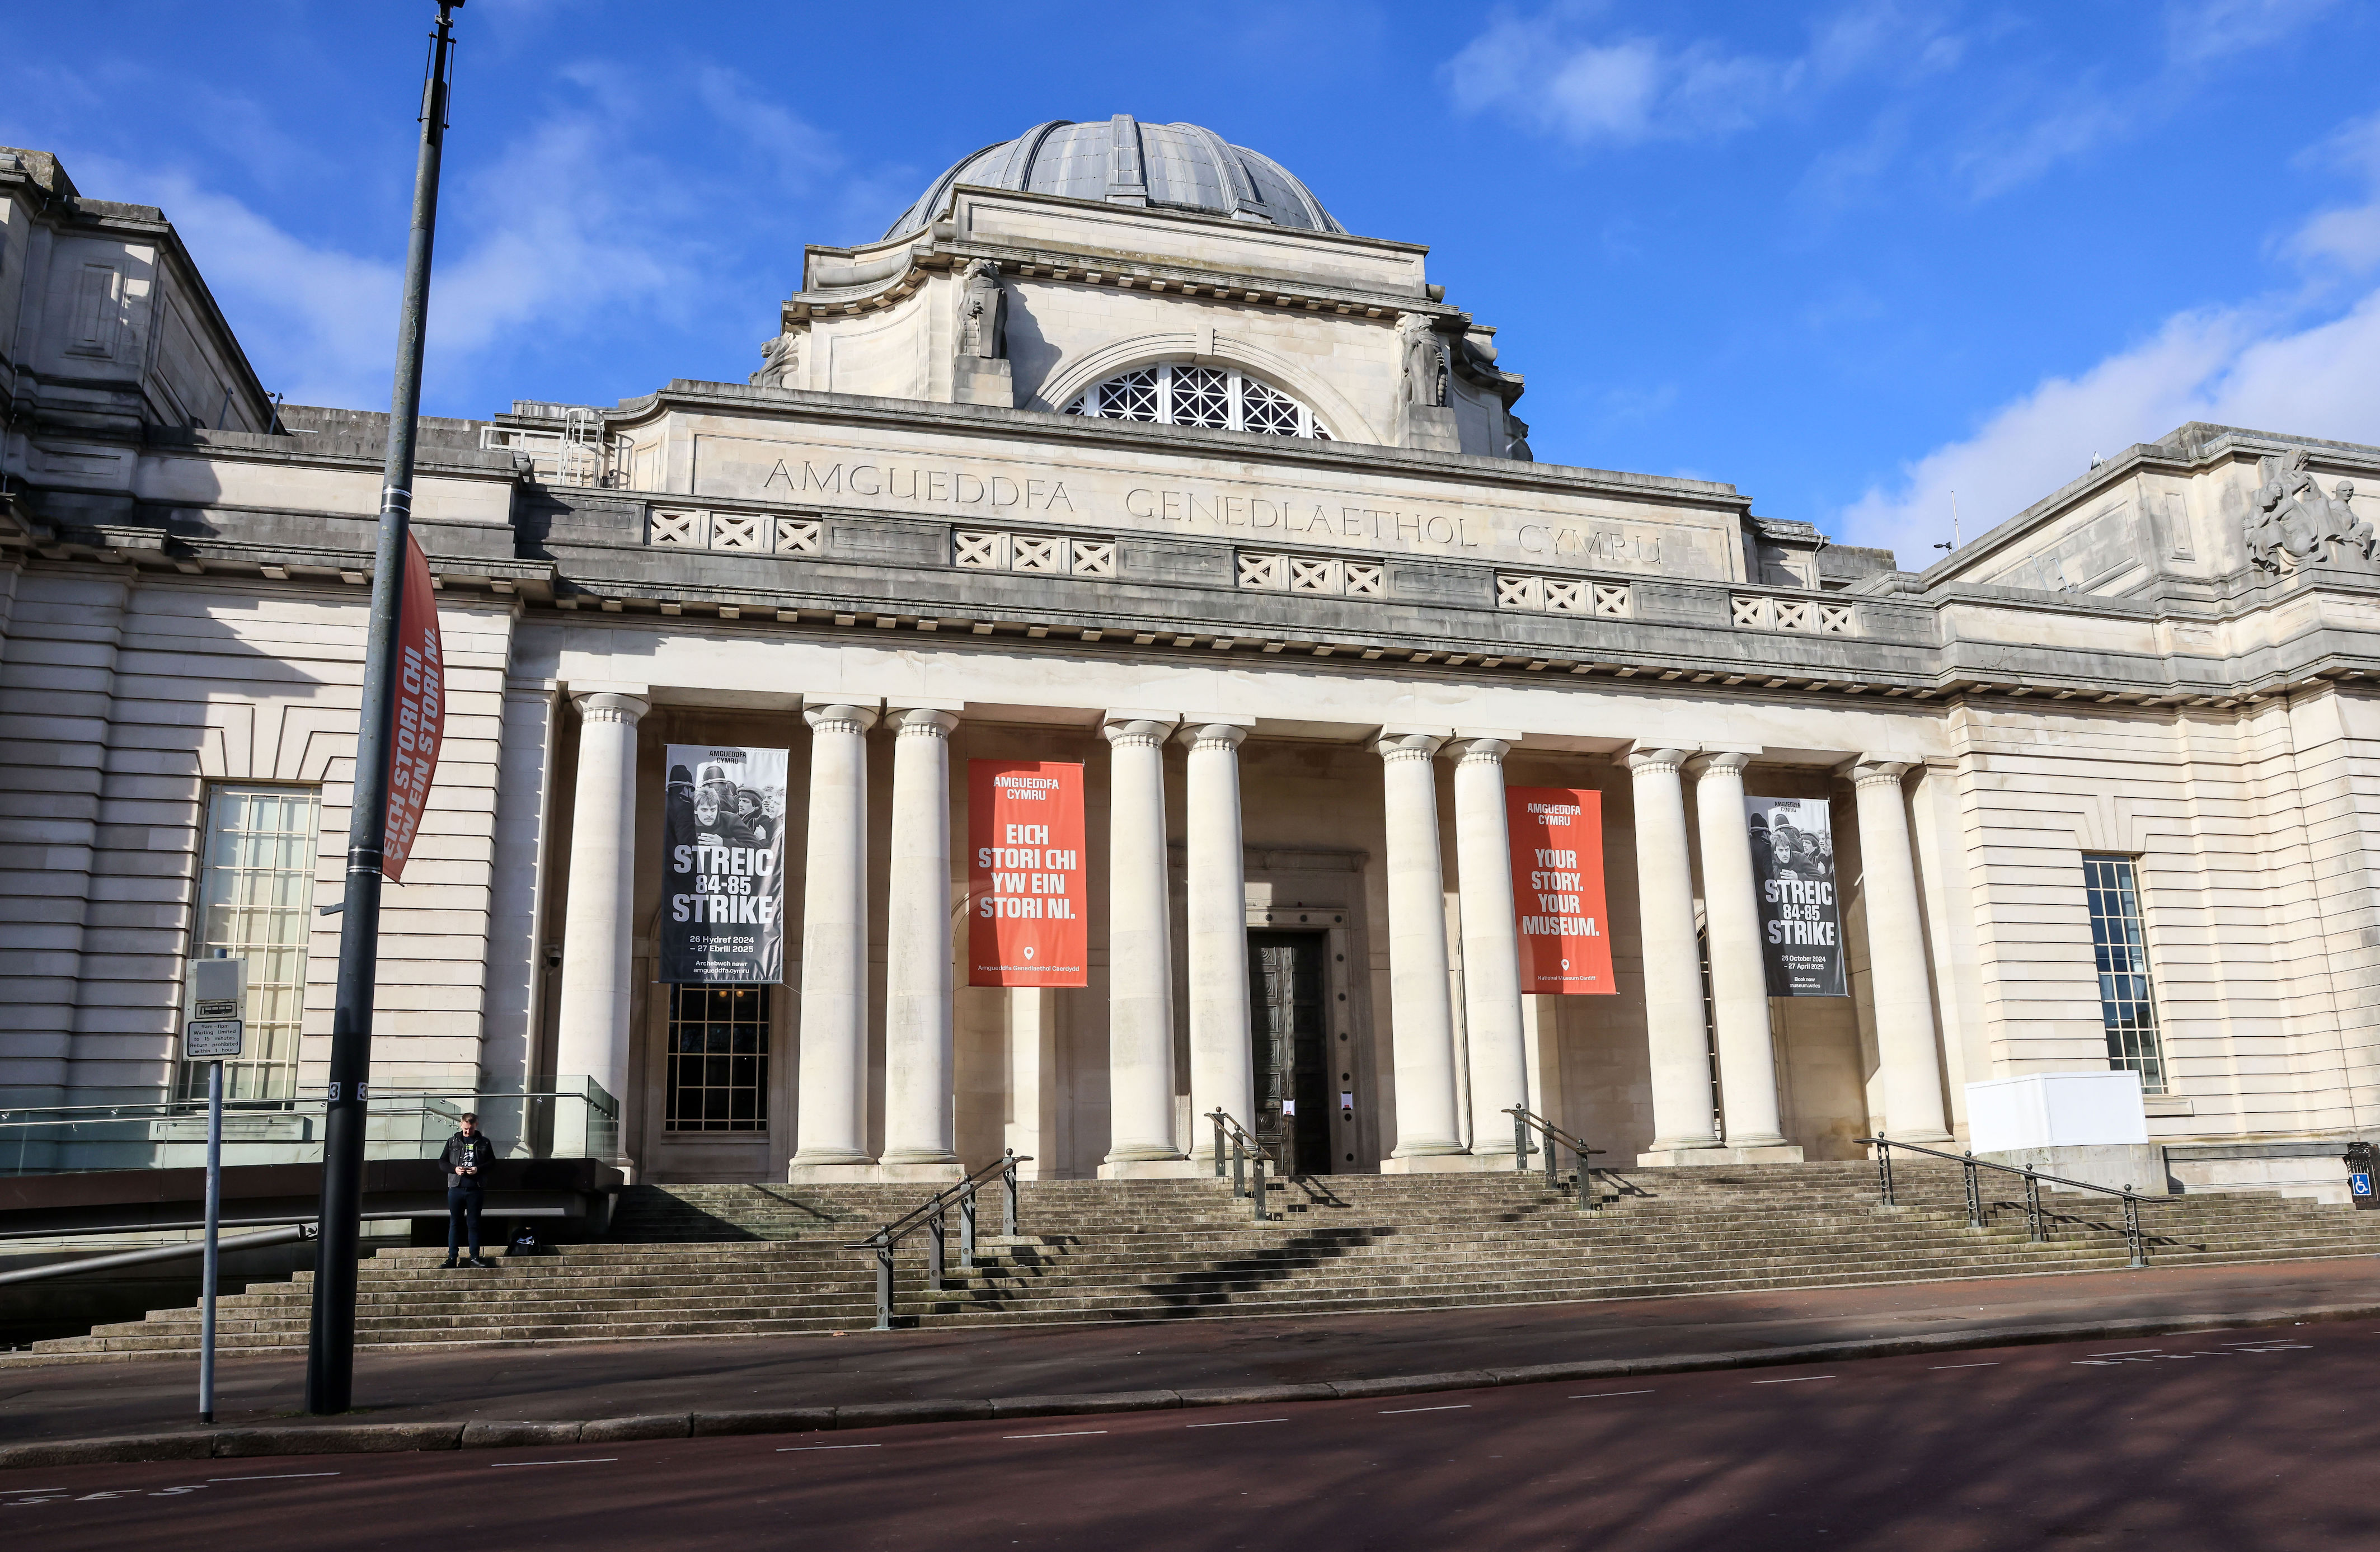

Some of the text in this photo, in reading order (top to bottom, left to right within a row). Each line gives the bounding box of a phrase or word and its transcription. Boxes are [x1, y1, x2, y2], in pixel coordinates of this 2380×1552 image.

[764, 459, 1663, 565] AMGUEDDFA GENEDLAETHOL CYMRU
[383, 645, 421, 858] EICH STORI CHI
[392, 627, 438, 860] YW EIN STORI NI.
[993, 776, 1059, 789] AMGUEDDFA
[1007, 789, 1046, 801] CYMRU
[1527, 803, 1581, 816] AMGUEDDFA
[1538, 815, 1570, 826] CYMRU
[1006, 824, 1049, 845] EICH
[674, 844, 773, 876] STREIC
[978, 848, 1076, 871] STORI CHI
[1534, 848, 1577, 869] YOUR
[696, 875, 751, 895] 84-85
[991, 872, 1065, 894] YW EIN
[1531, 871, 1584, 892] STORY.
[1764, 879, 1833, 905] STREIC
[672, 893, 773, 924] STRIKE
[980, 897, 1076, 919] STORI NI.
[1538, 893, 1580, 914] YOUR
[1783, 904, 1820, 921] 84-85
[1522, 916, 1600, 937] MUSEUM.
[1768, 920, 1835, 946] STRIKE
[702, 936, 731, 944] Hydref
[330, 1084, 339, 1099] 3
[359, 1084, 367, 1099] 3
[2071, 1346, 2313, 1365] BYSIAU
[0, 1485, 209, 1506] SES
